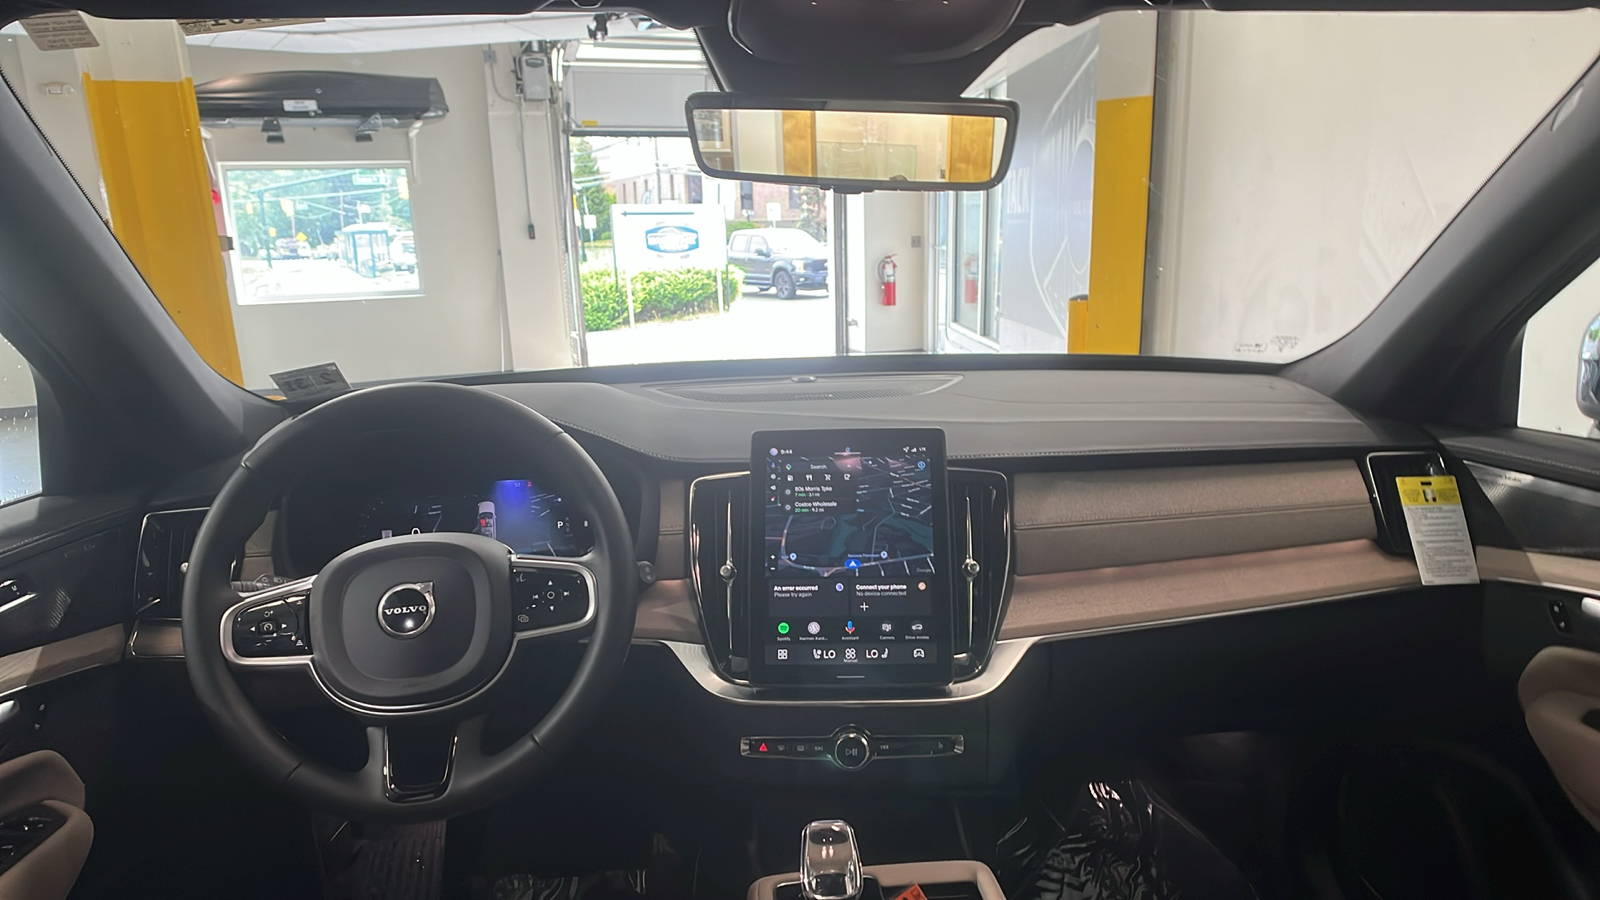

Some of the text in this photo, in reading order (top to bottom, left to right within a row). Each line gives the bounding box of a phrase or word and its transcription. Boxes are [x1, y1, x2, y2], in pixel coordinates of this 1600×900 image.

[557, 520, 564, 529] P
[384, 604, 427, 616] VOLVO
[823, 649, 836, 659] LO
[865, 649, 879, 659] LO
